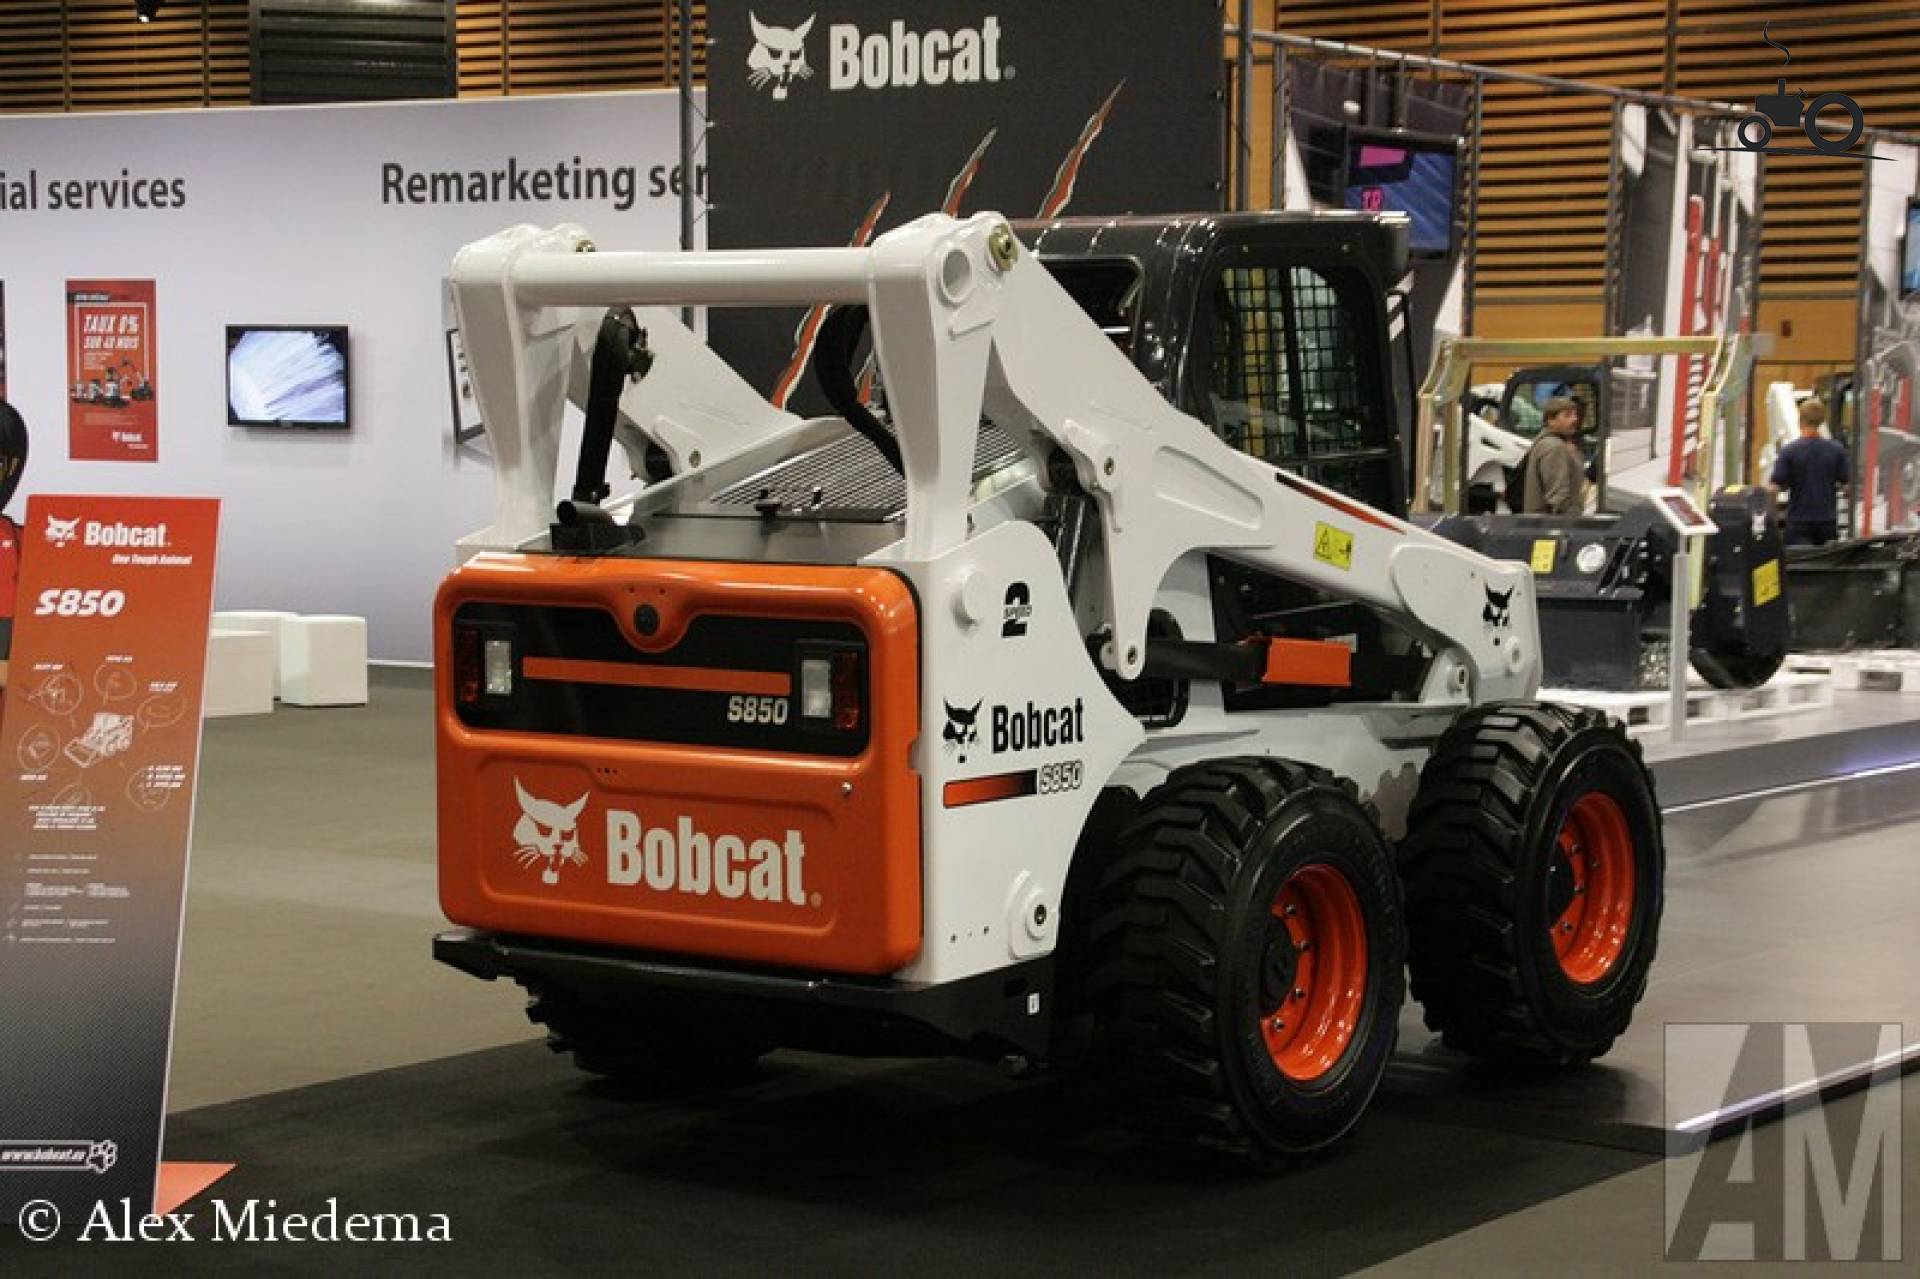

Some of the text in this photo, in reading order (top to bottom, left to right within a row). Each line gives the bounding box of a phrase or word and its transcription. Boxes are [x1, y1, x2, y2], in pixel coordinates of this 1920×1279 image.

[829, 16, 1001, 91] Bobcat
[0, 168, 186, 210] ial services
[382, 156, 636, 211] Remarketing
[83, 521, 168, 548] Bobcat
[34, 588, 126, 617] S850
[726, 695, 789, 726] S850
[991, 697, 1084, 754] Bobcat
[1039, 759, 1083, 795] S850
[605, 807, 807, 907] Bobcat
